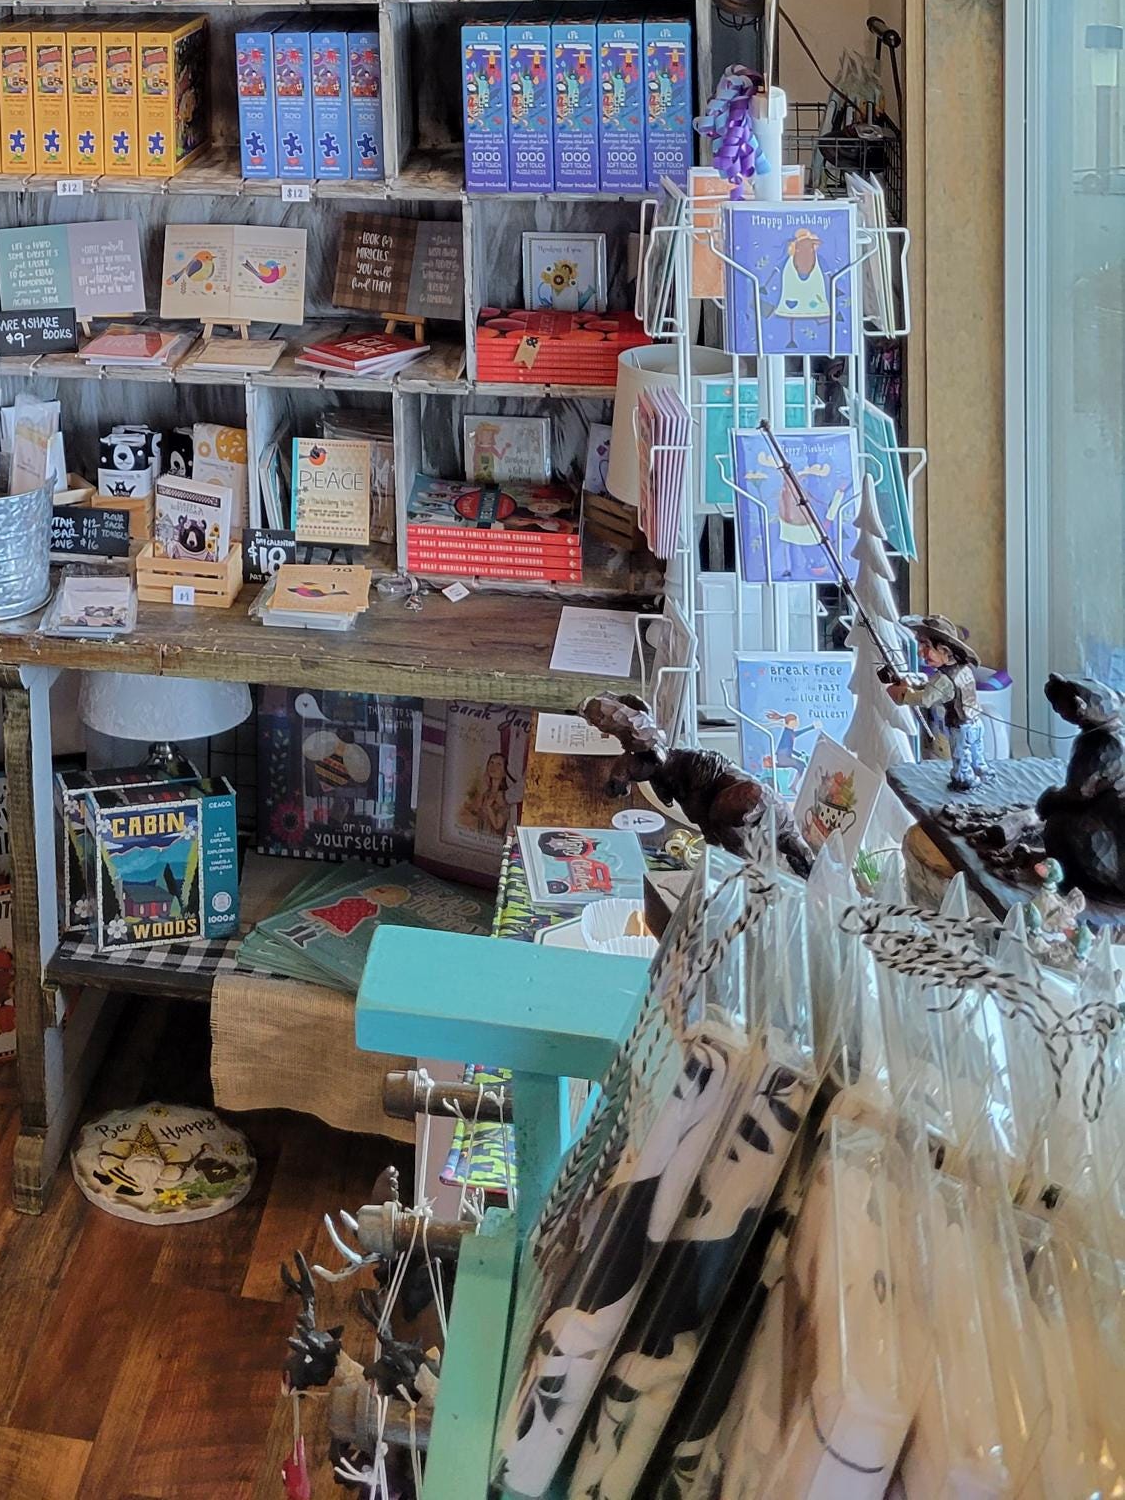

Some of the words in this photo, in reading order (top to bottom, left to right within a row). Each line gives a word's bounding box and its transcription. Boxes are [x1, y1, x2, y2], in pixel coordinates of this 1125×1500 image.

[472, 152, 501, 162] 1000
[516, 152, 545, 162] 1000
[561, 152, 590, 162] 1000
[607, 152, 637, 162] 1000
[653, 152, 684, 162] 1000
[62, 184, 77, 192] $12
[287, 188, 303, 198] $12
[363, 232, 380, 244] LOOK
[356, 247, 390, 261] MIRACLES
[356, 262, 372, 277] YOU
[374, 265, 393, 278] will
[351, 277, 371, 290] find
[372, 279, 392, 294] THEM
[27, 316, 59, 330] SHARE
[43, 327, 73, 340] BOOKS
[299, 470, 364, 491] PEACE
[82, 517, 100, 528] $12
[83, 528, 98, 538] $14
[417, 527, 434, 536] GREAT
[436, 528, 463, 537] AMERICAN
[465, 530, 485, 538] FAMILY
[487, 531, 511, 540] REUNION
[80, 538, 99, 550] $16
[419, 539, 436, 548] GREAT
[438, 541, 465, 549] AMERICAN
[467, 542, 487, 551] FAMILY
[489, 544, 513, 552] REUNION
[247, 541, 286, 574] $18
[419, 551, 436, 559] GREAT
[438, 552, 466, 561] AMERICAN
[467, 554, 487, 562] FAMILY
[489, 556, 513, 564] REUNION
[420, 563, 437, 571] GREAT
[439, 564, 467, 572] AMERICAN
[468, 566, 488, 574] FAMILY
[490, 567, 514, 575] REUNION
[770, 665, 809, 675] Break
[815, 664, 843, 675] free
[112, 812, 185, 838] CABIN
[314, 832, 394, 852] yourself!
[208, 915, 229, 923] 1000
[133, 918, 198, 939] WOODS
[95, 1122, 131, 1139] Bee
[159, 1116, 217, 1140] Happy
